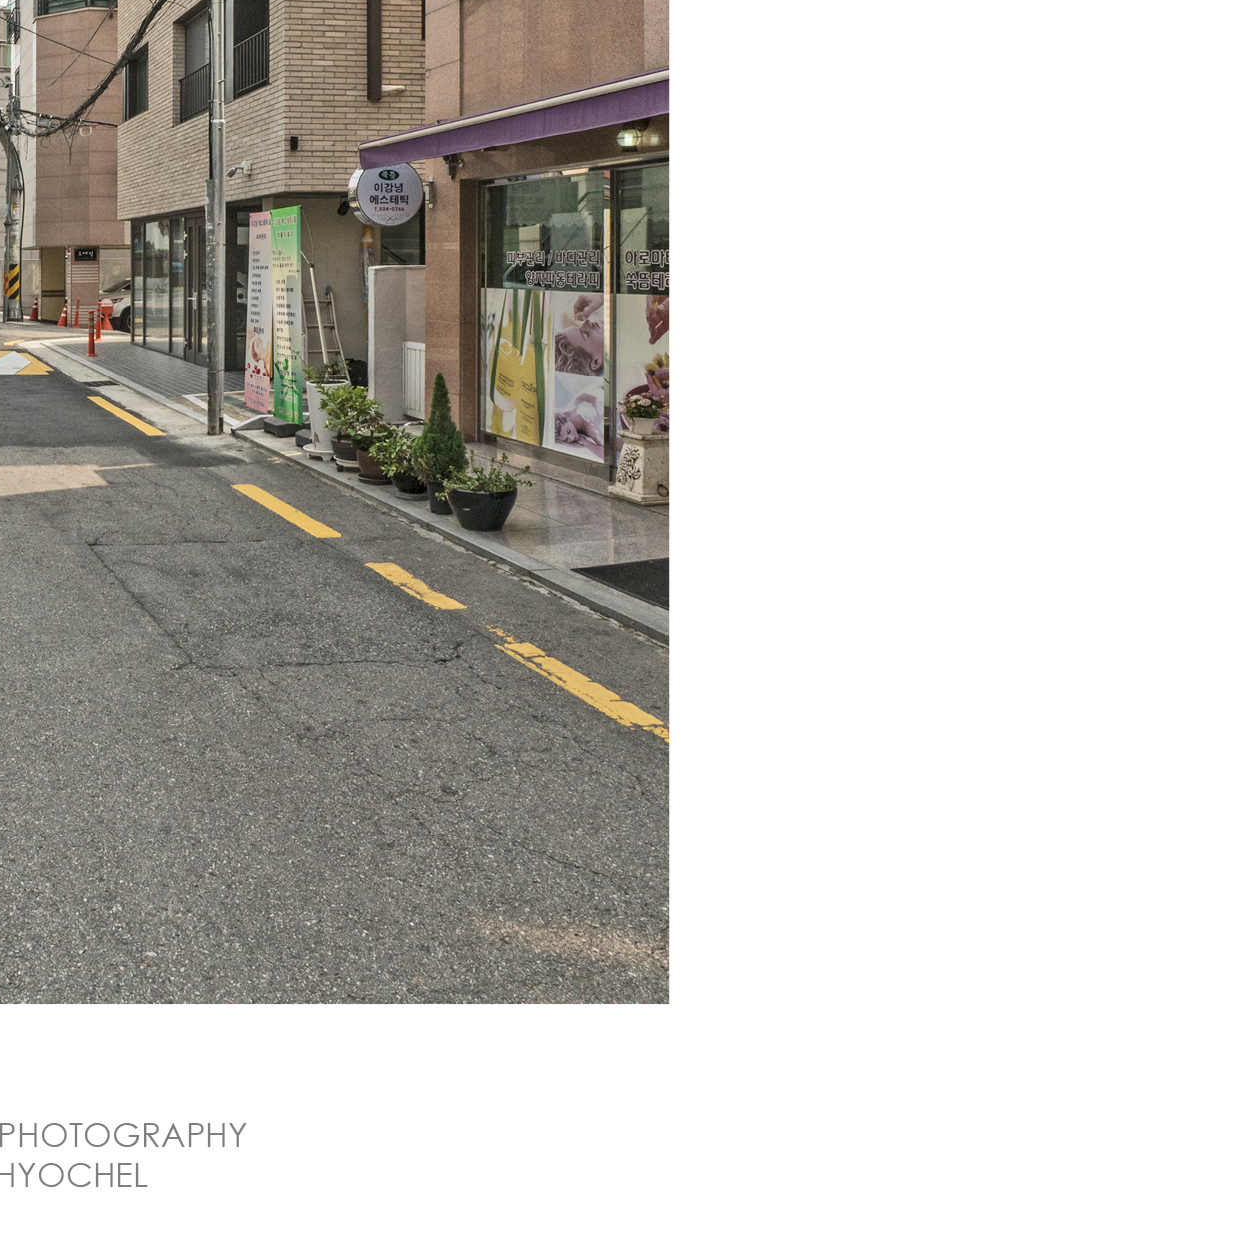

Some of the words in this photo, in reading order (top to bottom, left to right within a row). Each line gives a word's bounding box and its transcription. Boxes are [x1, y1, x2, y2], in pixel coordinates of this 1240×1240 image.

[374, 182, 404, 194] 이강녕
[369, 194, 409, 205] 에스테틱
[506, 250, 546, 267] 피부관리
[555, 249, 601, 268] 바디관리
